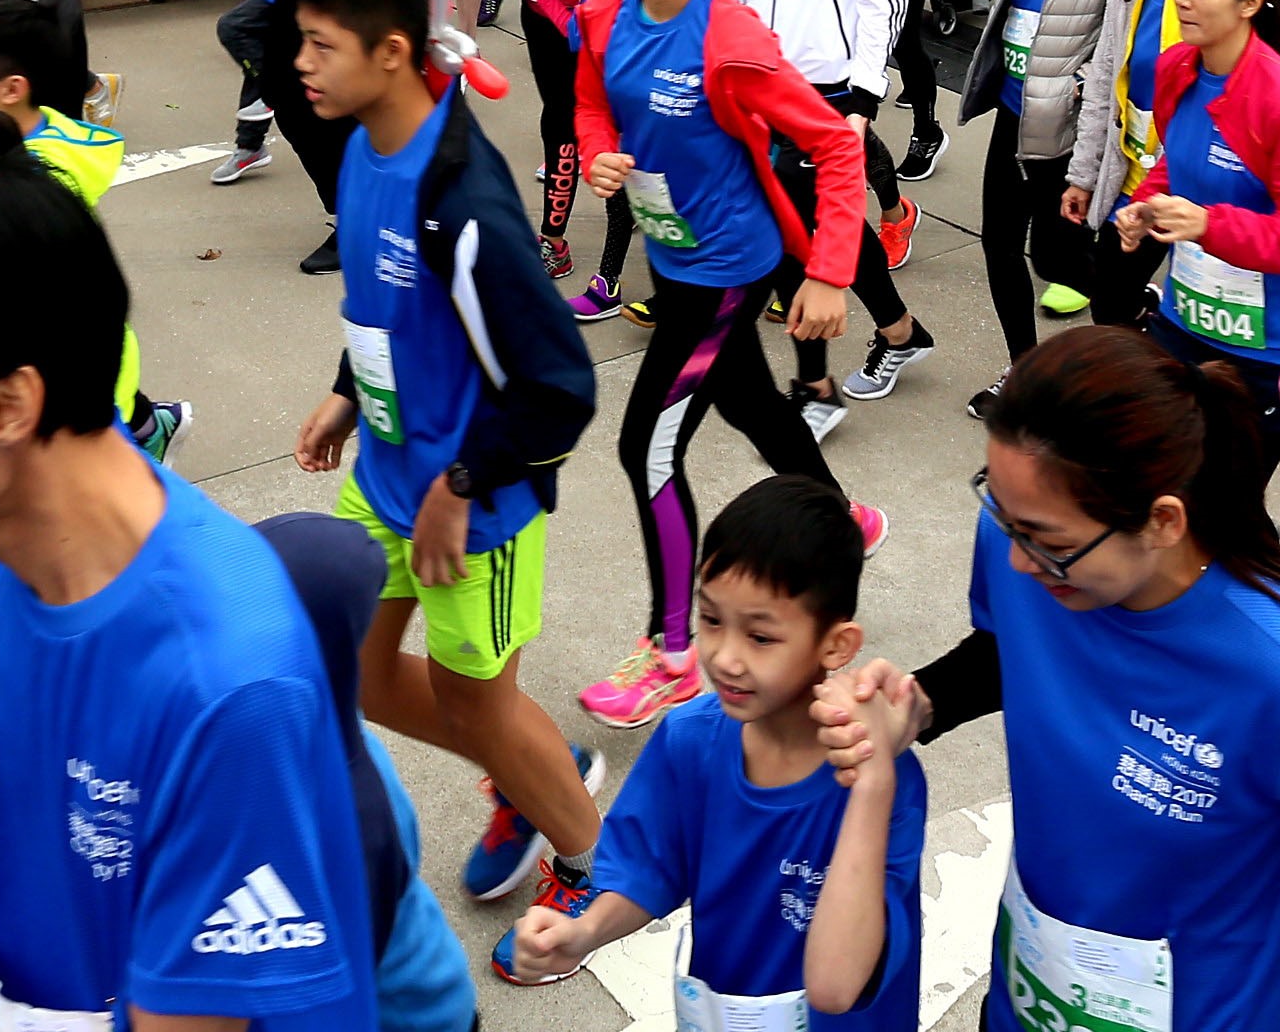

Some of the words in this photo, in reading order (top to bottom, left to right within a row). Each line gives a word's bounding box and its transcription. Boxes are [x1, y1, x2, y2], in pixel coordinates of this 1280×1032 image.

[549, 142, 575, 227] adidas
[1175, 288, 1255, 341] F1504
[1130, 709, 1198, 757] unicef
[1112, 775, 1167, 816] Charity
[1168, 803, 1204, 824] Run
[192, 919, 327, 955] adidas
